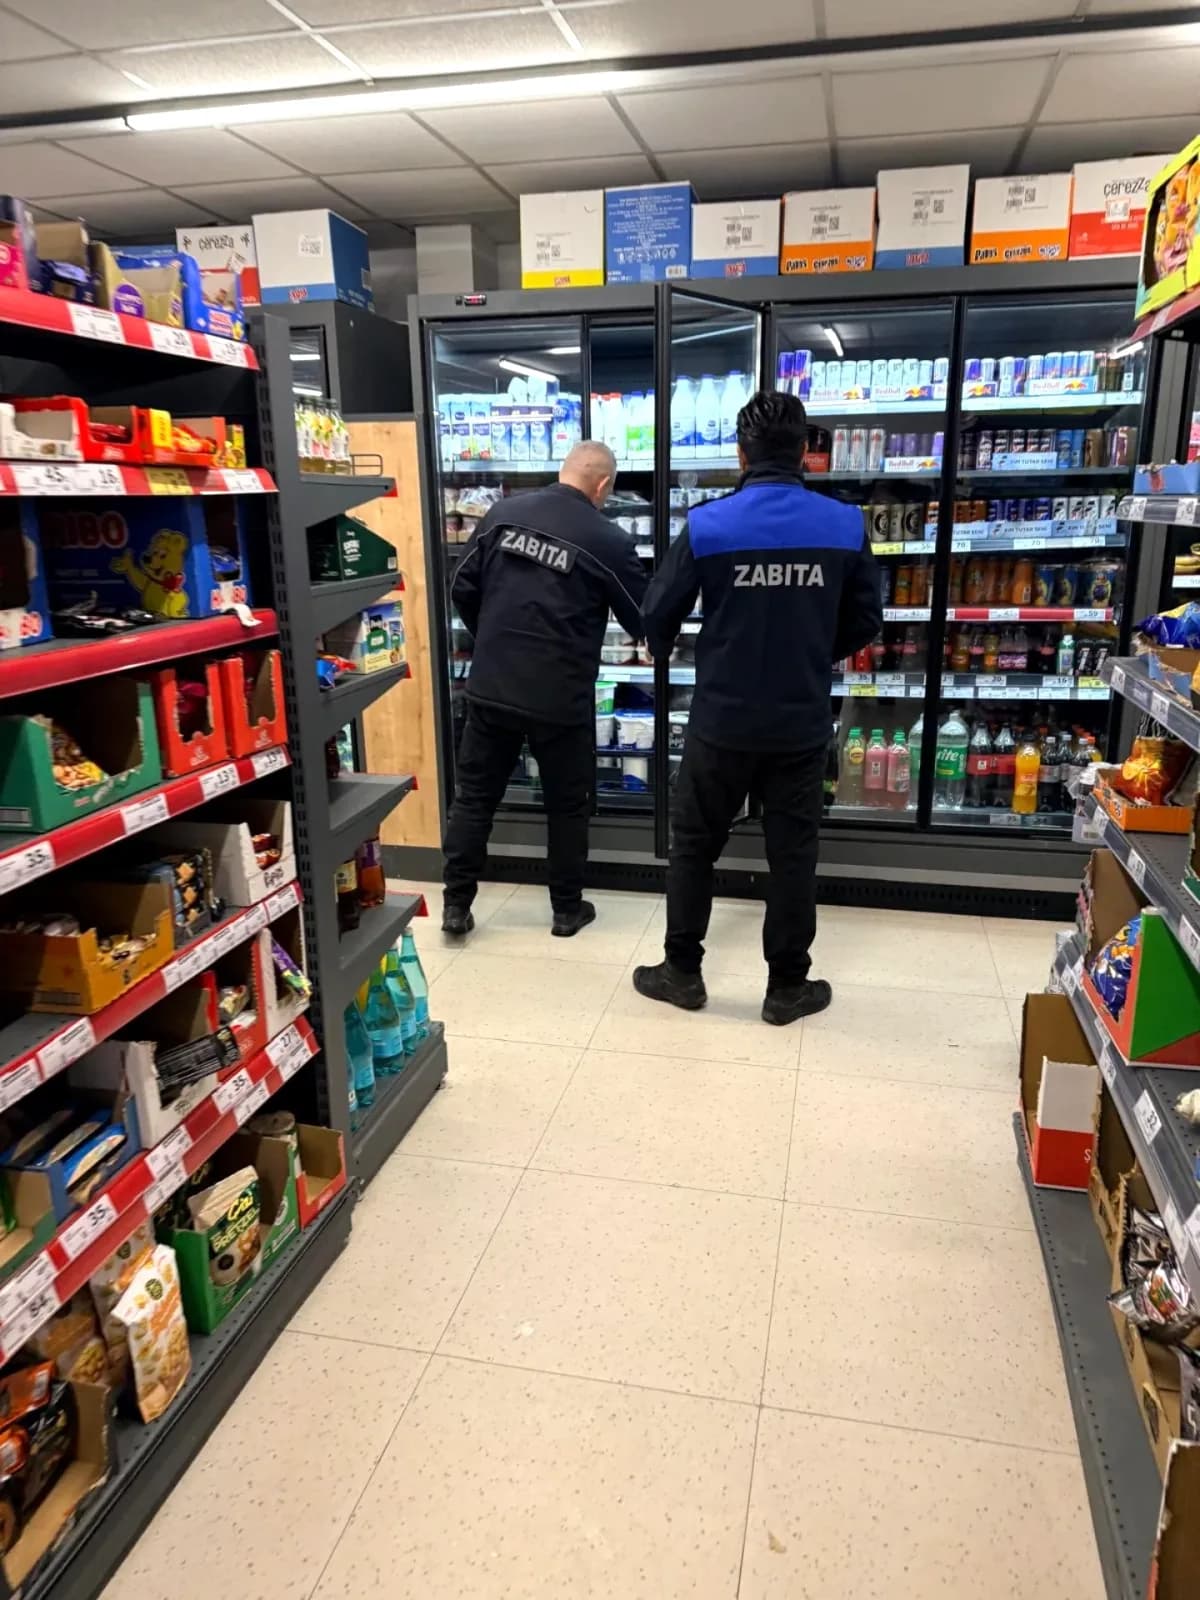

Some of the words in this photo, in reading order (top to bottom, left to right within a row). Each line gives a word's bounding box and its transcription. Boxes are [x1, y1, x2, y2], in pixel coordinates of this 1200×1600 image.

[500, 530, 569, 571] ZABITA
[734, 563, 825, 587] ZABITA
[936, 748, 960, 762] rite
